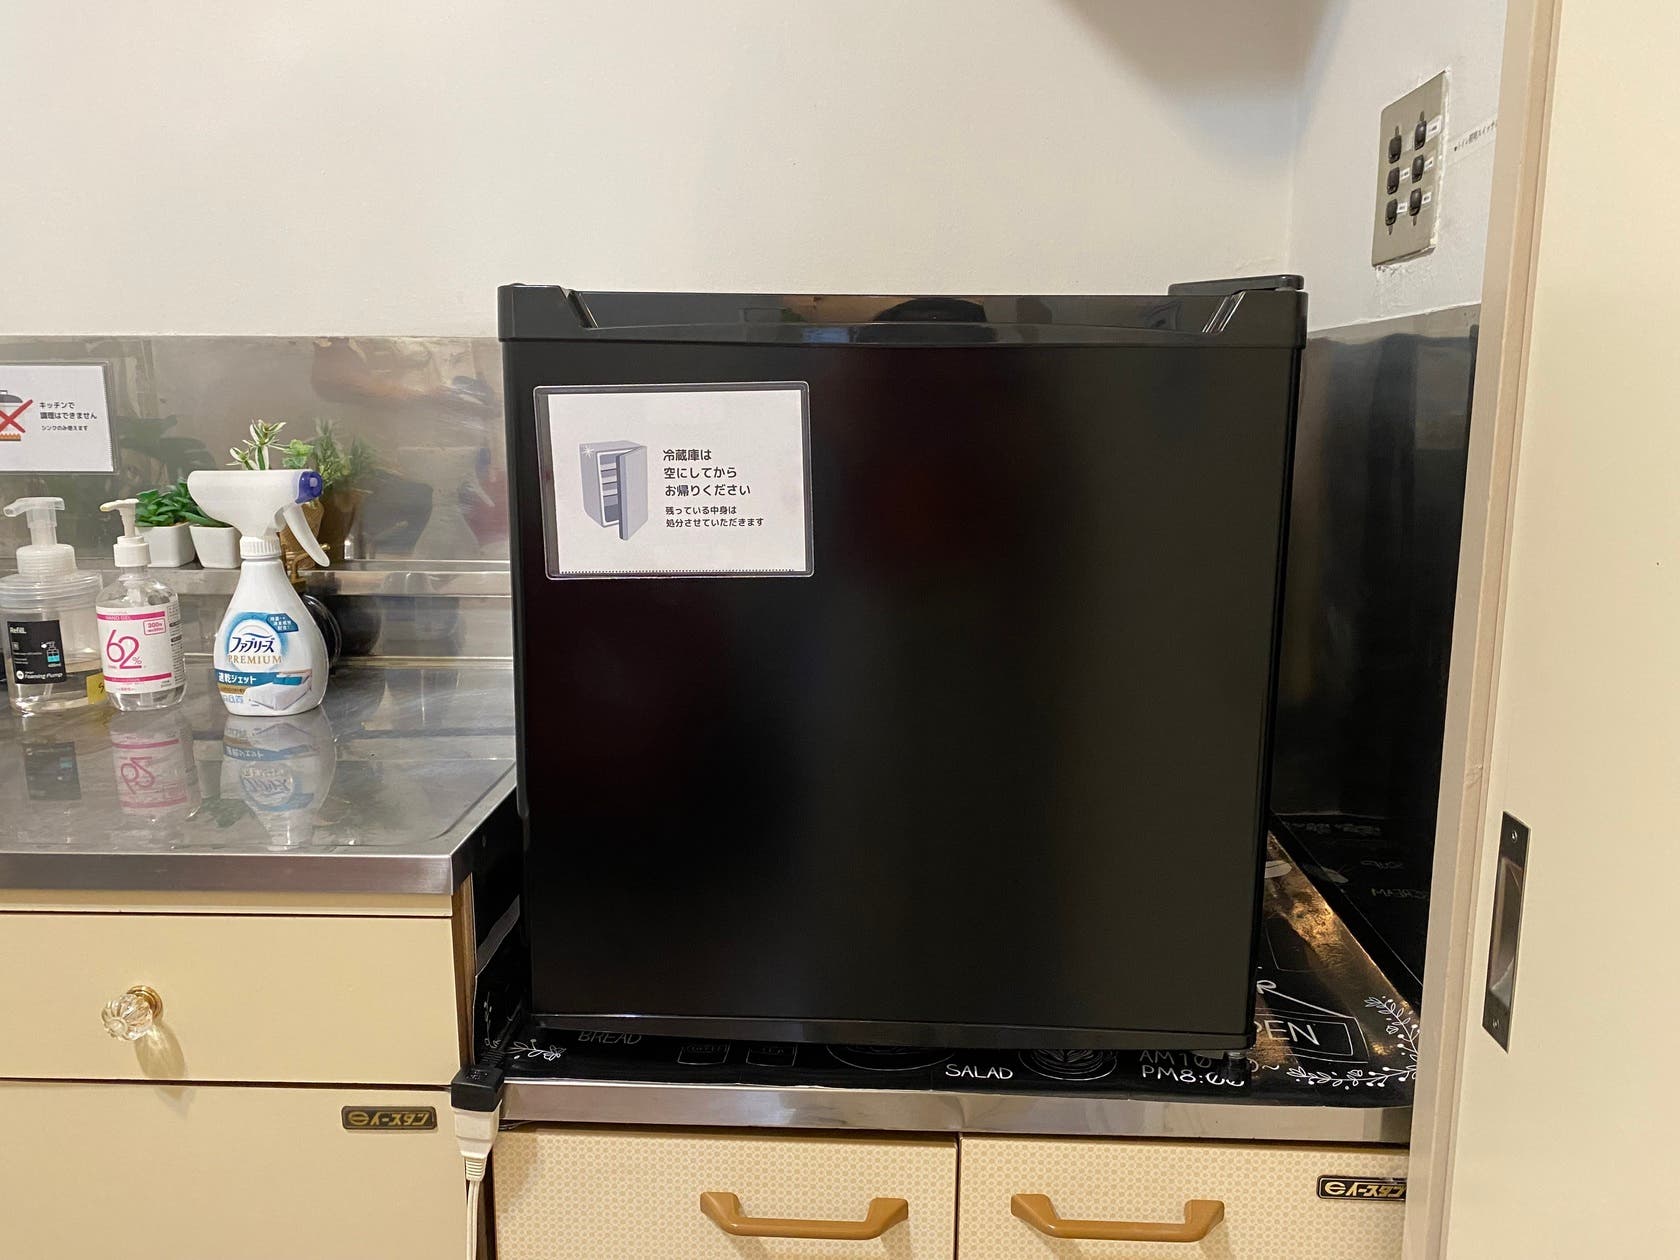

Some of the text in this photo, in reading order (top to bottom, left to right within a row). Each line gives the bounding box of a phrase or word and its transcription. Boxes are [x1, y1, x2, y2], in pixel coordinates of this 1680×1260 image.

[39, 401, 76, 410] キッチンで
[39, 411, 98, 420] 調理はできません
[662, 449, 712, 462] 冷蔵庫は
[663, 466, 738, 480] 空にしてから
[665, 484, 751, 497] お帰りください
[665, 505, 737, 516] 残っている中身は
[665, 517, 765, 528] 処分させていただきます
[229, 636, 276, 654] ファブリーズ
[228, 654, 283, 666] PREMIUM
[24, 672, 63, 681] Foaming Pump
[577, 1028, 644, 1046] BREAD
[944, 1063, 1014, 1081] SALAD
